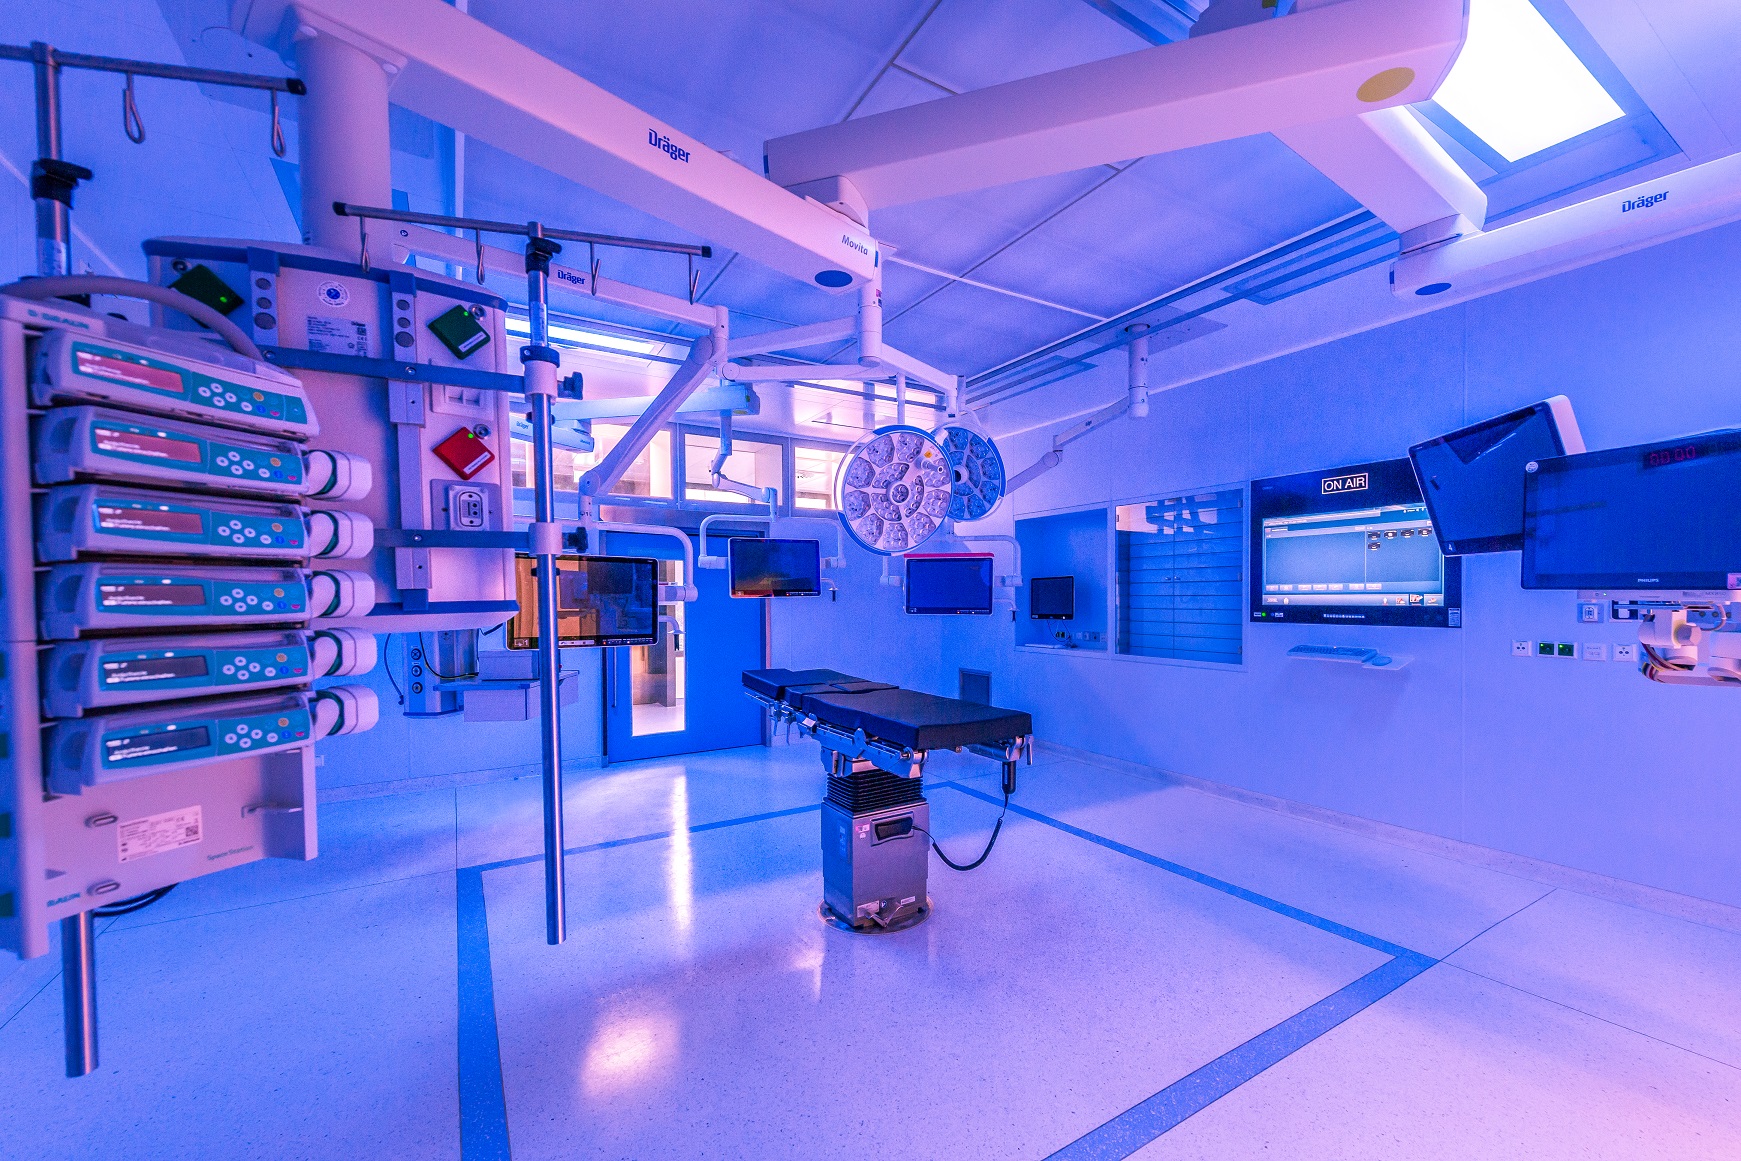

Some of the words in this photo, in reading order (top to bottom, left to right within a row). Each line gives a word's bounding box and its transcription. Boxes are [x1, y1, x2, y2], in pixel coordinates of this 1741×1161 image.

[648, 128, 690, 163] Dräger
[1622, 191, 1669, 213] Dräger
[841, 235, 868, 256] Movita
[557, 269, 585, 285] Dräger
[1324, 480, 1342, 491] ON
[1345, 477, 1365, 488] AIR
